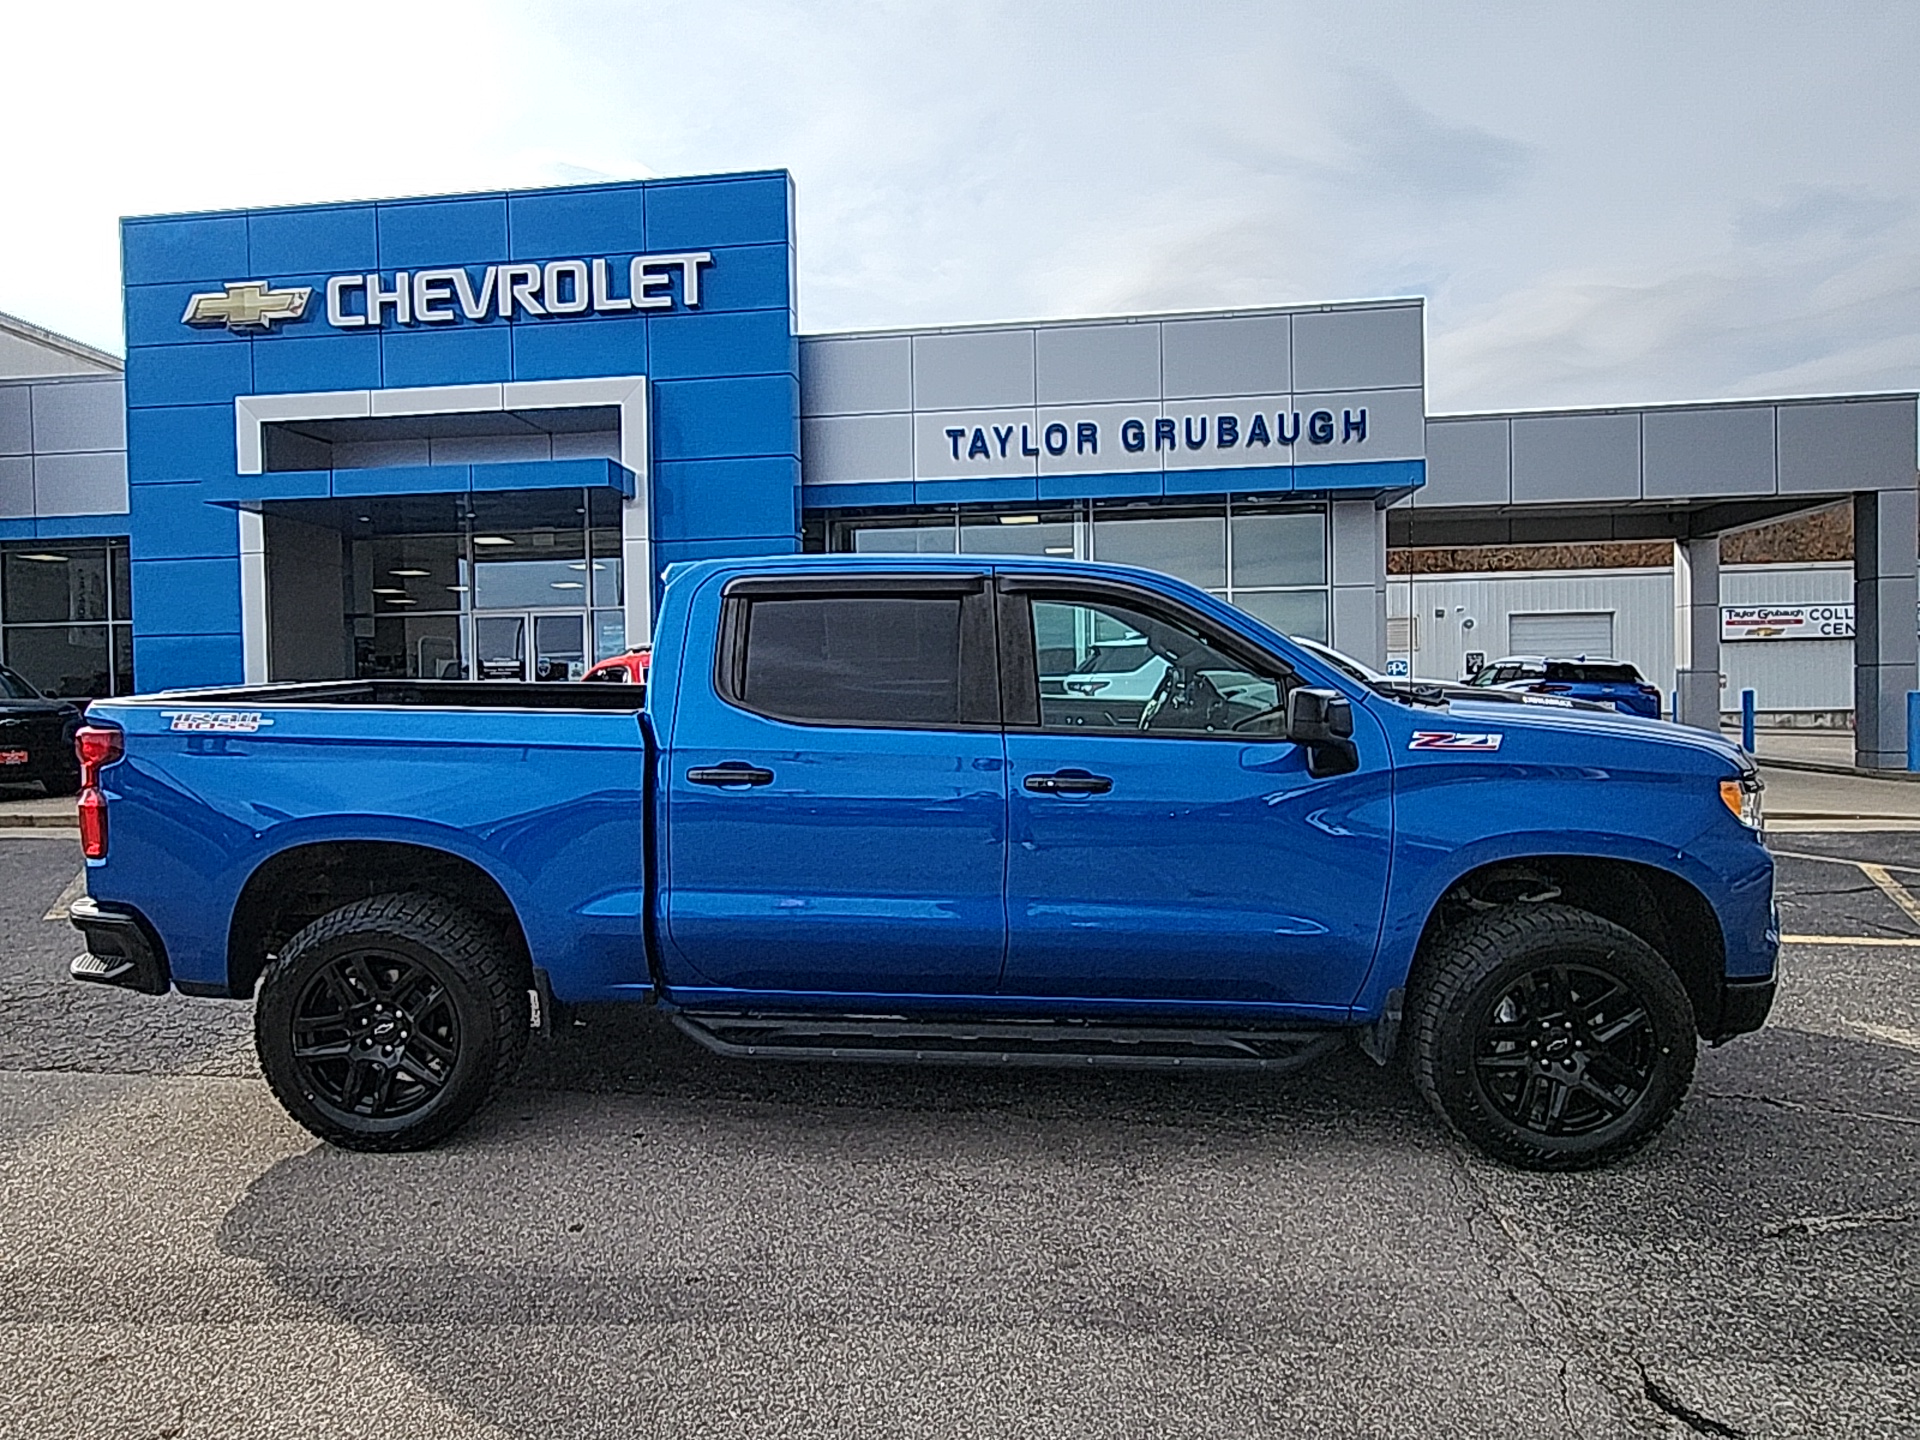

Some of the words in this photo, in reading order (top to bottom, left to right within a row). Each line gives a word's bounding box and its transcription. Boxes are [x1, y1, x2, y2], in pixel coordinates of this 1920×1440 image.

[326, 252, 711, 327] CHEVROLET
[945, 421, 1098, 460] TAYLOR
[1121, 408, 1369, 451] GRUBAUGH
[1726, 609, 1756, 620] Taylor
[1757, 609, 1804, 620] Grubaugh
[1387, 662, 1408, 675] PPG
[1408, 731, 1503, 751] Z71
